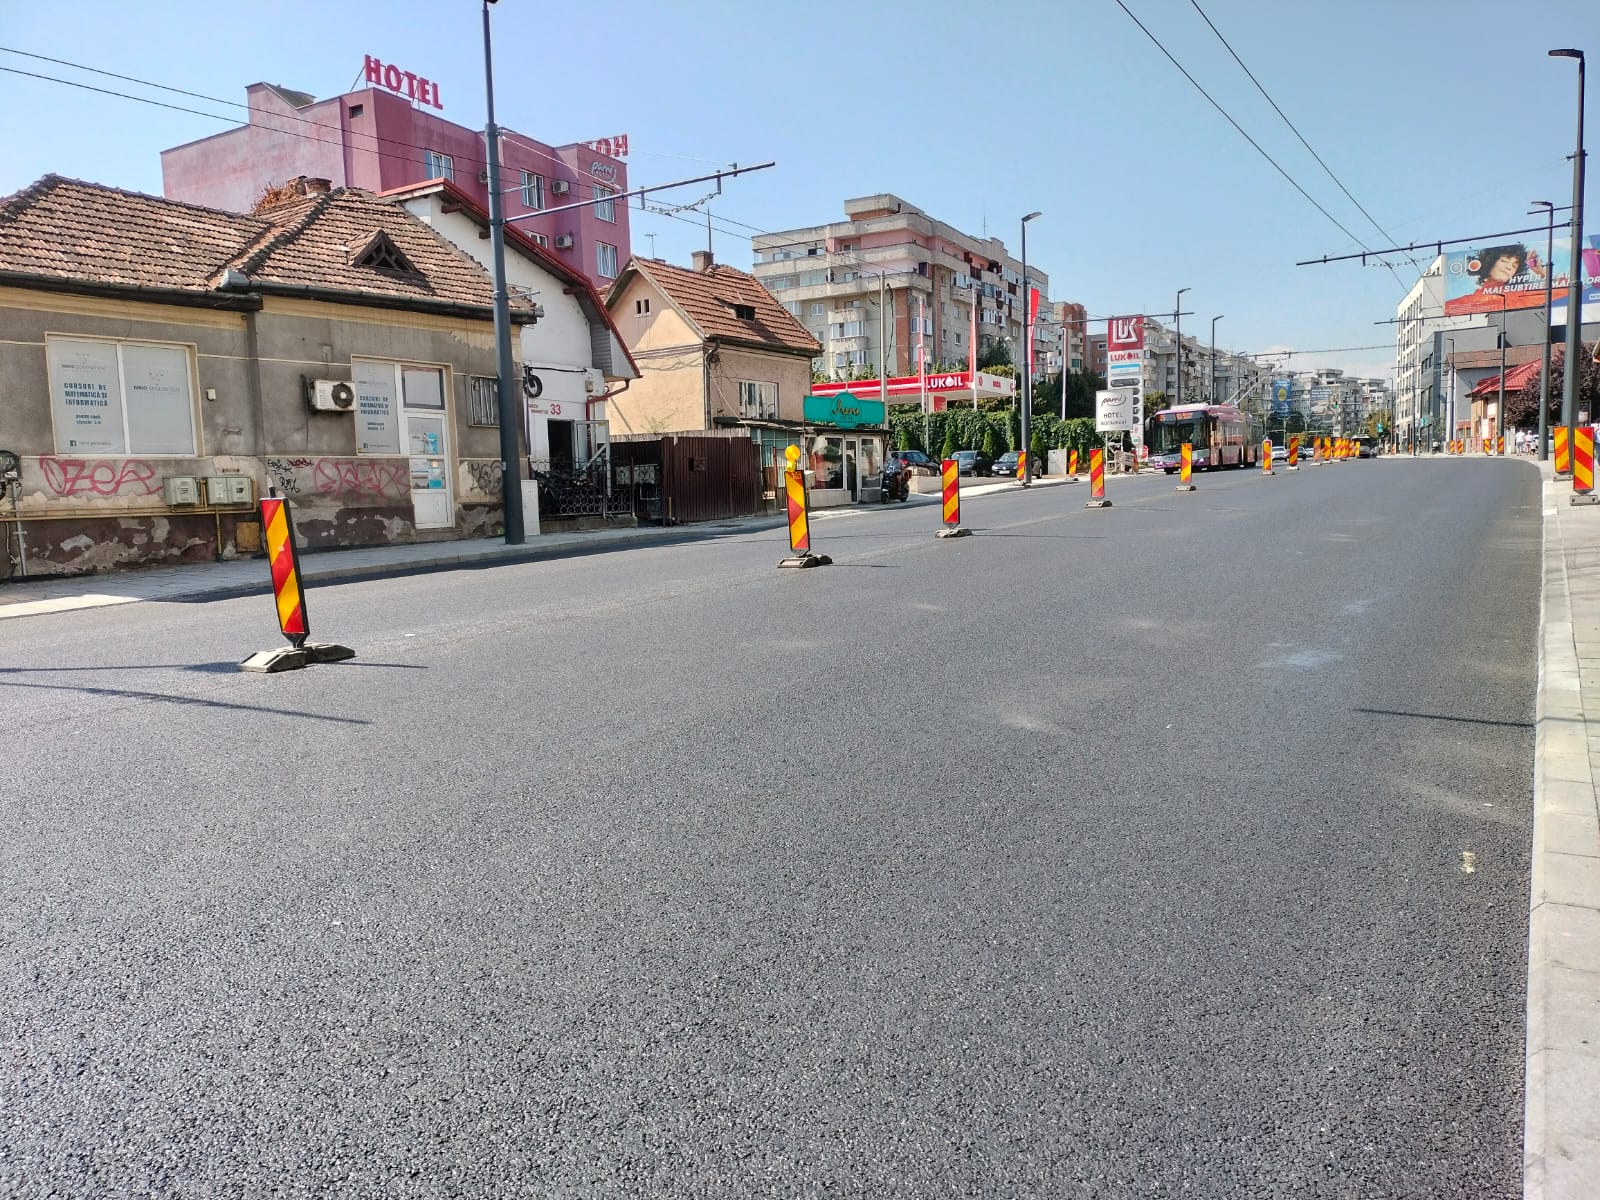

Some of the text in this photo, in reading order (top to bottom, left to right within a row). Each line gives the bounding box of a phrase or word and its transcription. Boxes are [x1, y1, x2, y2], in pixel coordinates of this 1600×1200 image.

[365, 54, 443, 110] HOTEL
[1508, 274, 1542, 284] HYPER
[1113, 318, 1138, 343] LUK
[1110, 353, 1140, 361] LUKOIL
[926, 376, 963, 389] LUKOIL
[551, 403, 561, 415] 33
